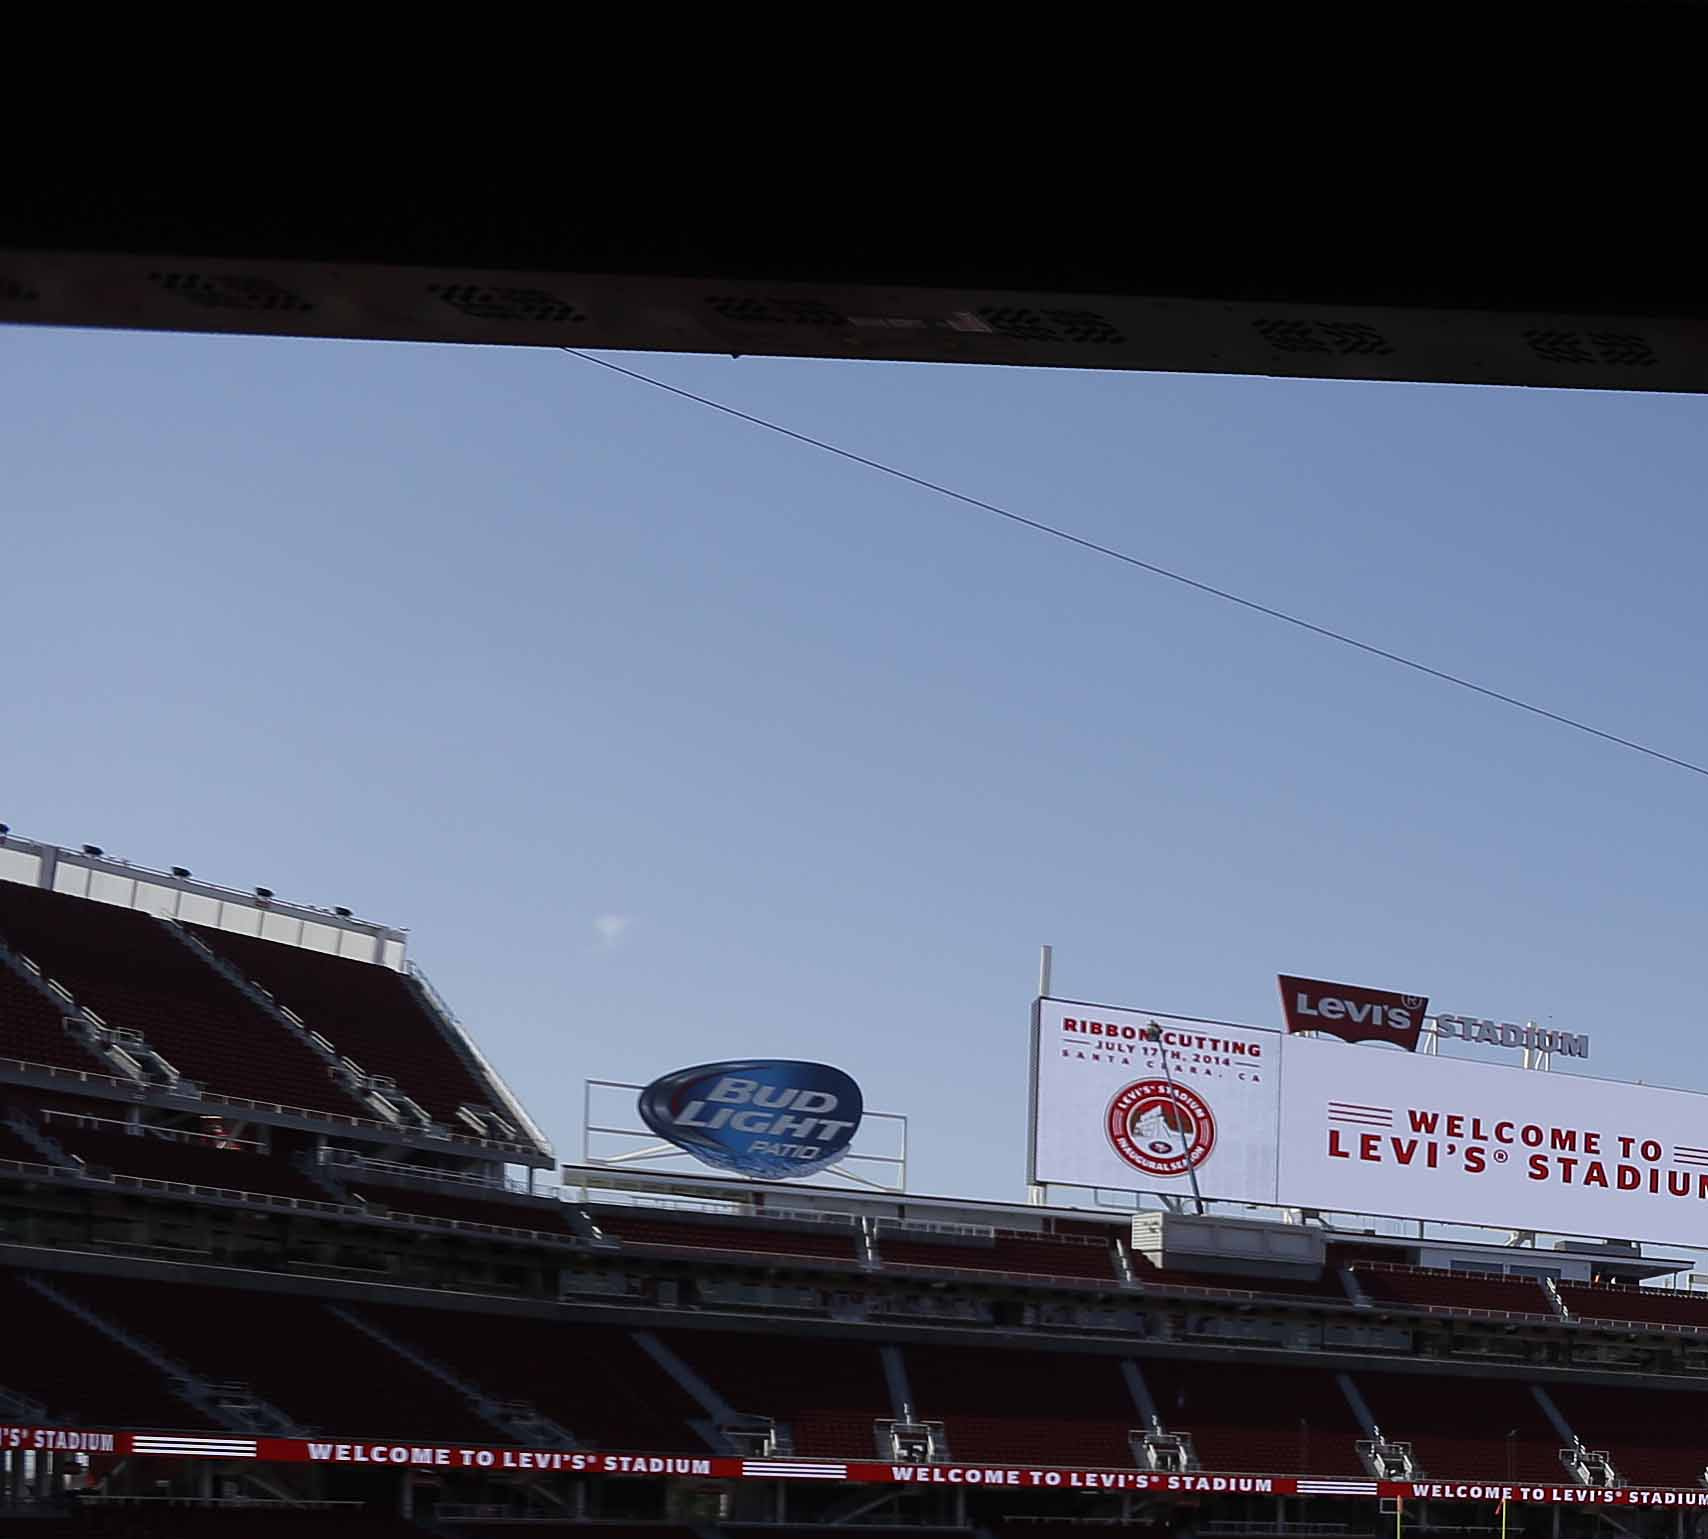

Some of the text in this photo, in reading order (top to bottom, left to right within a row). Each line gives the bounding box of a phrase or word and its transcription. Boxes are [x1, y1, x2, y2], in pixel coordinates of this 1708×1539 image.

[1062, 1017, 1262, 1058] RIBBON CUTTING
[1434, 1013, 1590, 1059] STADIUM
[1061, 1049, 1131, 1065] SANTA
[1237, 1072, 1261, 1083] CA
[1095, 1041, 1136, 1054] JULY
[1192, 1053, 1231, 1067] 2014
[706, 1077, 839, 1114] BUD
[673, 1100, 856, 1141] LIGHT
[1407, 1109, 1662, 1162] WELCOME TO
[747, 1140, 822, 1160] PATIO
[33, 1429, 114, 1452] STADIUM
[307, 1443, 451, 1466] WELCOME
[459, 1450, 495, 1467] TO
[603, 1456, 710, 1475] STADIUM
[892, 1466, 1020, 1485] WELCOME
[1029, 1471, 1061, 1487] TO
[1167, 1475, 1272, 1493] STADIUM
[1412, 1483, 1513, 1500] WELCOME
[1519, 1487, 1545, 1501] TO
